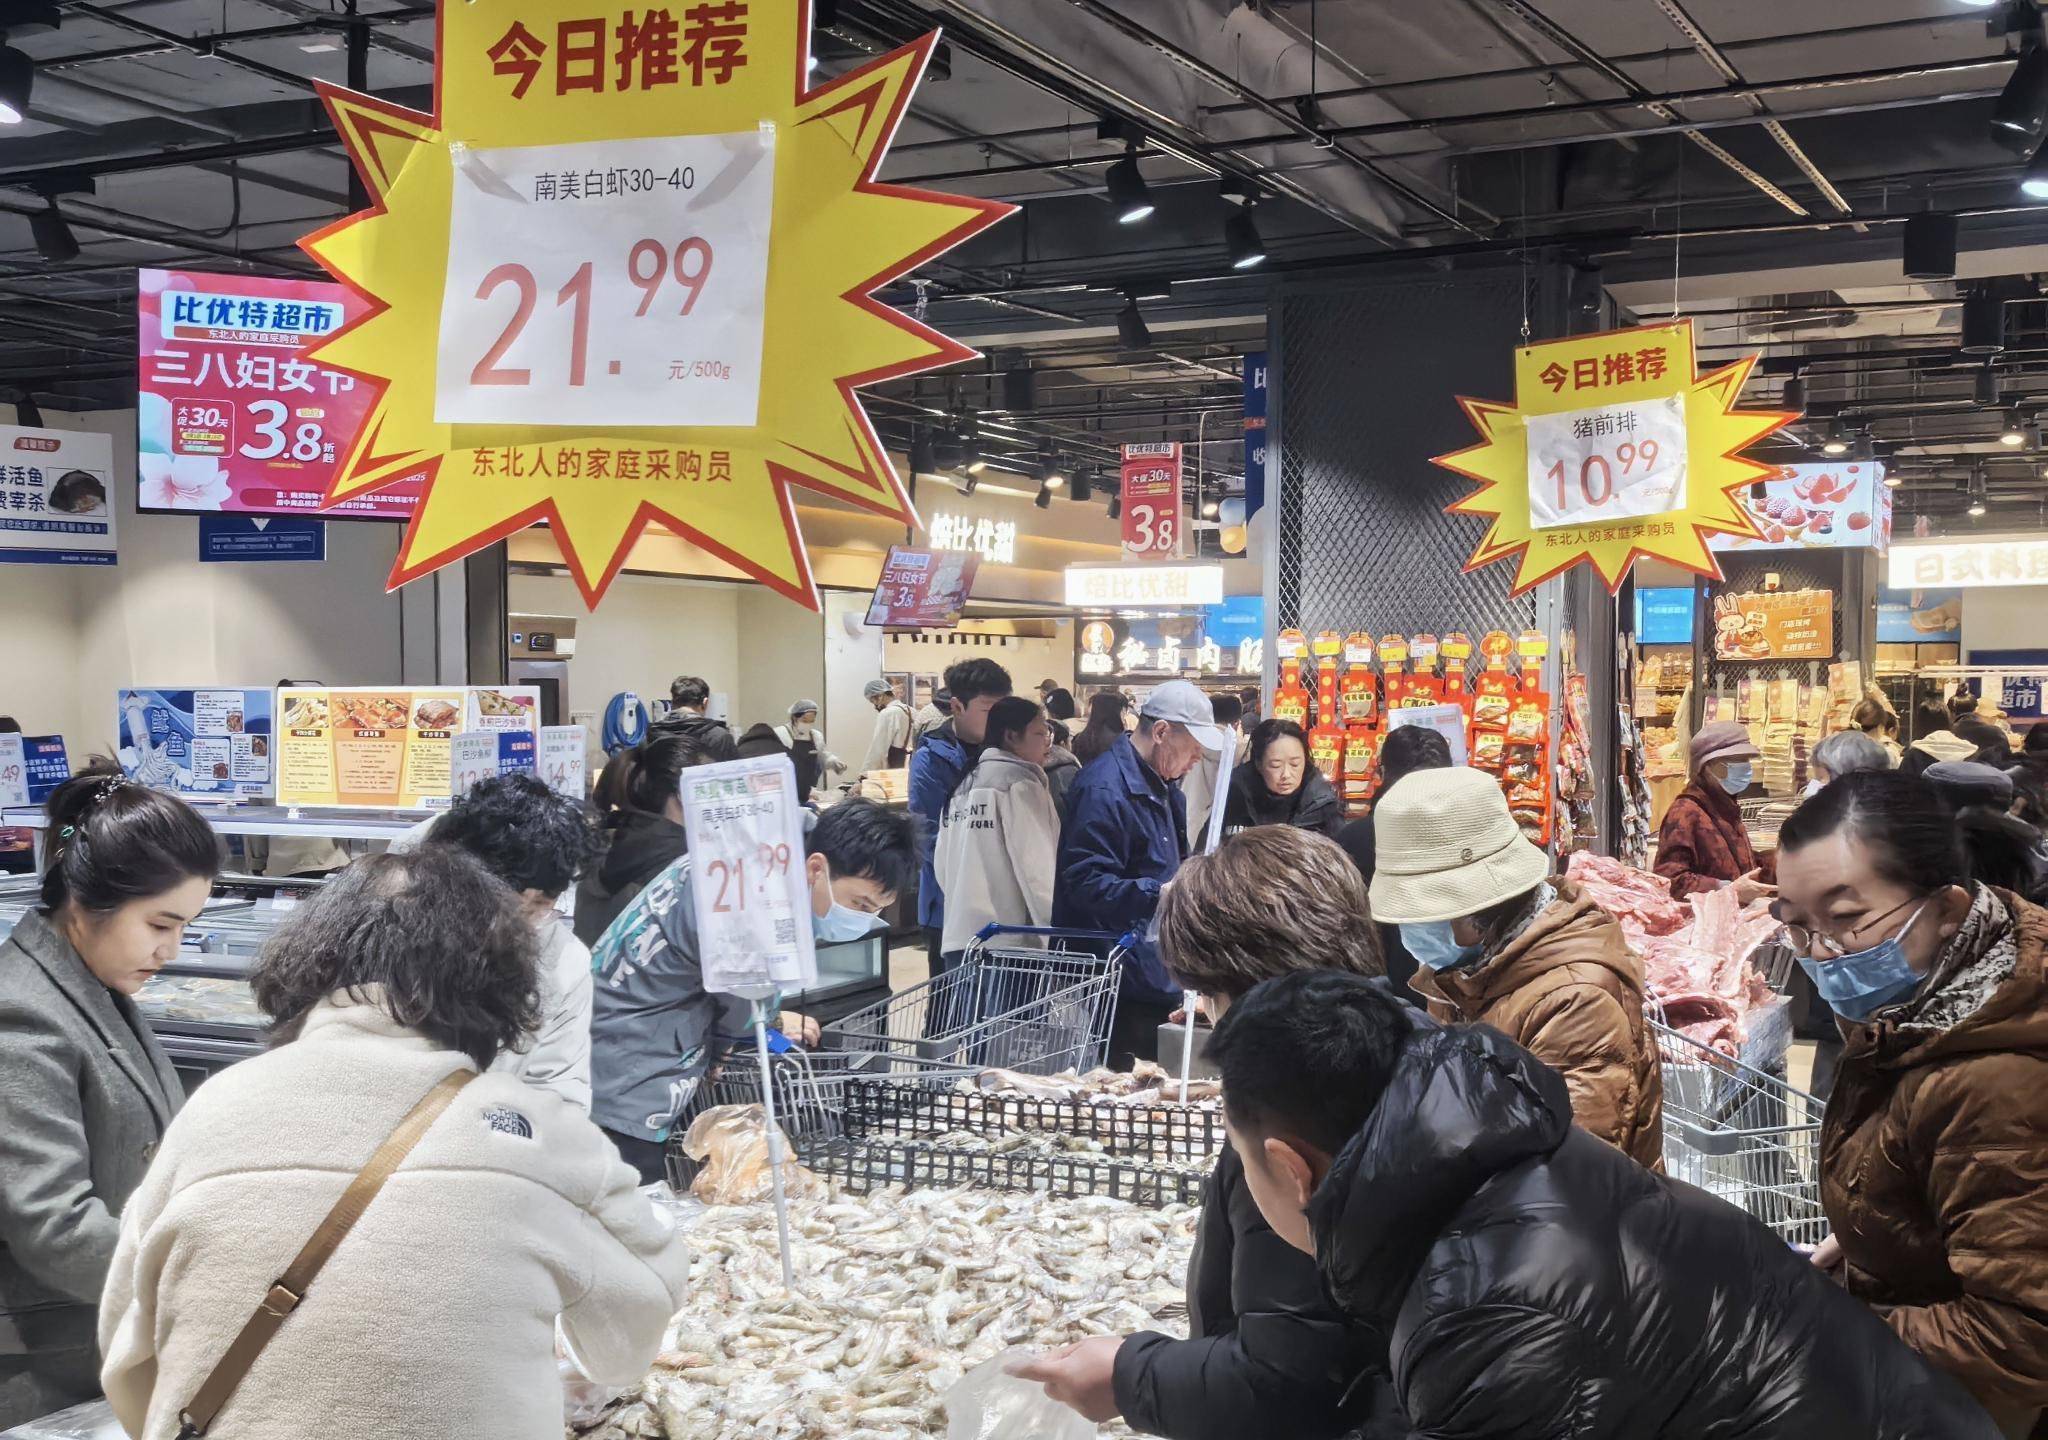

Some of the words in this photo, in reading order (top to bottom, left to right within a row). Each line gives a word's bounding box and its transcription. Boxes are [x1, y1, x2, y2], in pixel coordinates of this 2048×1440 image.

[487, 3, 748, 99] 今日推荐
[535, 166, 695, 202] 南美白虾30-40
[173, 295, 334, 332] 比优特超市
[151, 349, 356, 395] 三八妇女节
[668, 360, 731, 381] 元/500g
[1538, 347, 1669, 393] 今日推荐
[239, 399, 323, 462] 3.8
[1573, 411, 1638, 439] 猪前排
[473, 446, 733, 482] 东北人的家庭采购员
[1127, 504, 1174, 552] 3.8
[1545, 522, 1676, 547] 东北人的家庭采购员
[491, 1121, 518, 1135] FACE
